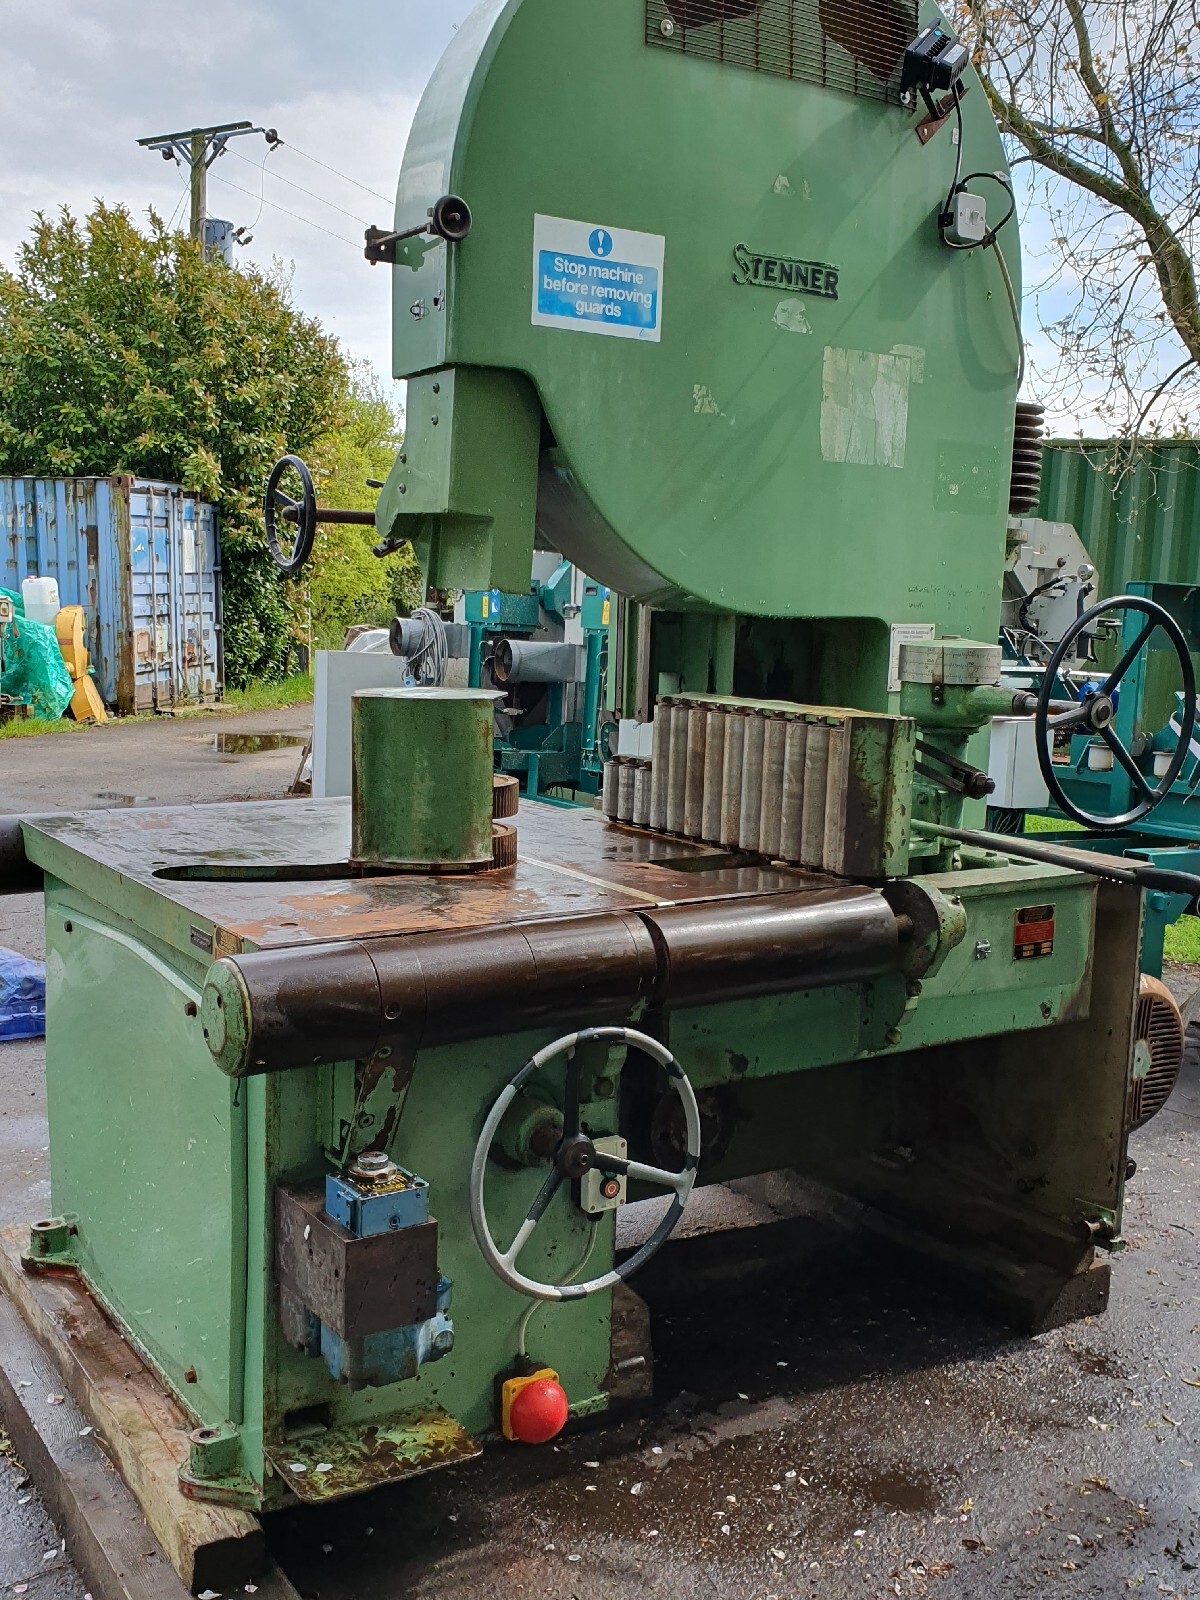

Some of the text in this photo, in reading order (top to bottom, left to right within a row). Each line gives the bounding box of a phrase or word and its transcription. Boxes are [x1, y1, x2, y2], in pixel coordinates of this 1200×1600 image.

[554, 257, 644, 284] Stop machine
[733, 243, 839, 298] STENNER
[543, 275, 652, 309] before removing
[575, 300, 621, 317] guards
